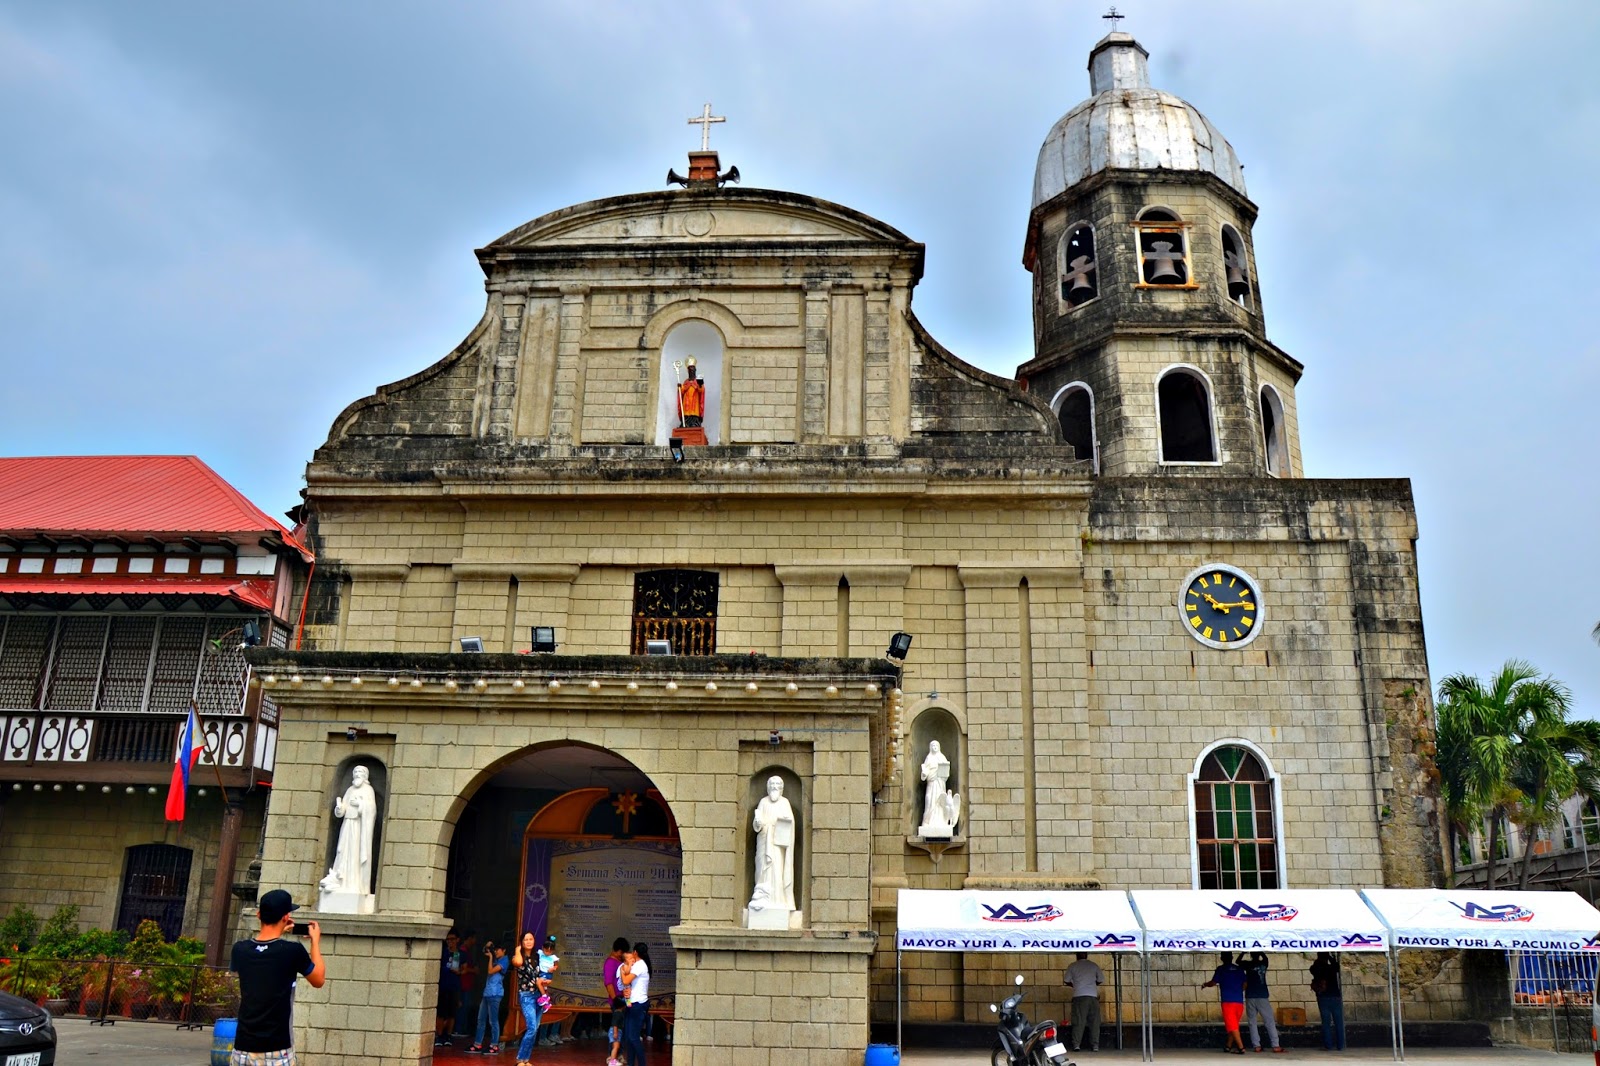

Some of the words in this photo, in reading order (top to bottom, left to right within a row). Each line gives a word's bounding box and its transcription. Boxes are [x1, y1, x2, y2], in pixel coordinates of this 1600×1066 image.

[614, 866, 646, 879] Santa
[902, 938, 956, 948] MAYOR
[961, 939, 997, 948] YURI
[1002, 939, 1017, 948] A.
[1022, 940, 1092, 948] PACUMIO
[1153, 939, 1206, 948] MAYOR
[1211, 939, 1246, 948] YURI
[1252, 940, 1266, 948] A.
[1271, 940, 1339, 948] PACUMIO
[1397, 936, 1450, 946] MAYOR
[1454, 938, 1488, 947] YURI
[1493, 939, 1508, 948] A.
[1512, 940, 1580, 950] PACUMIO
